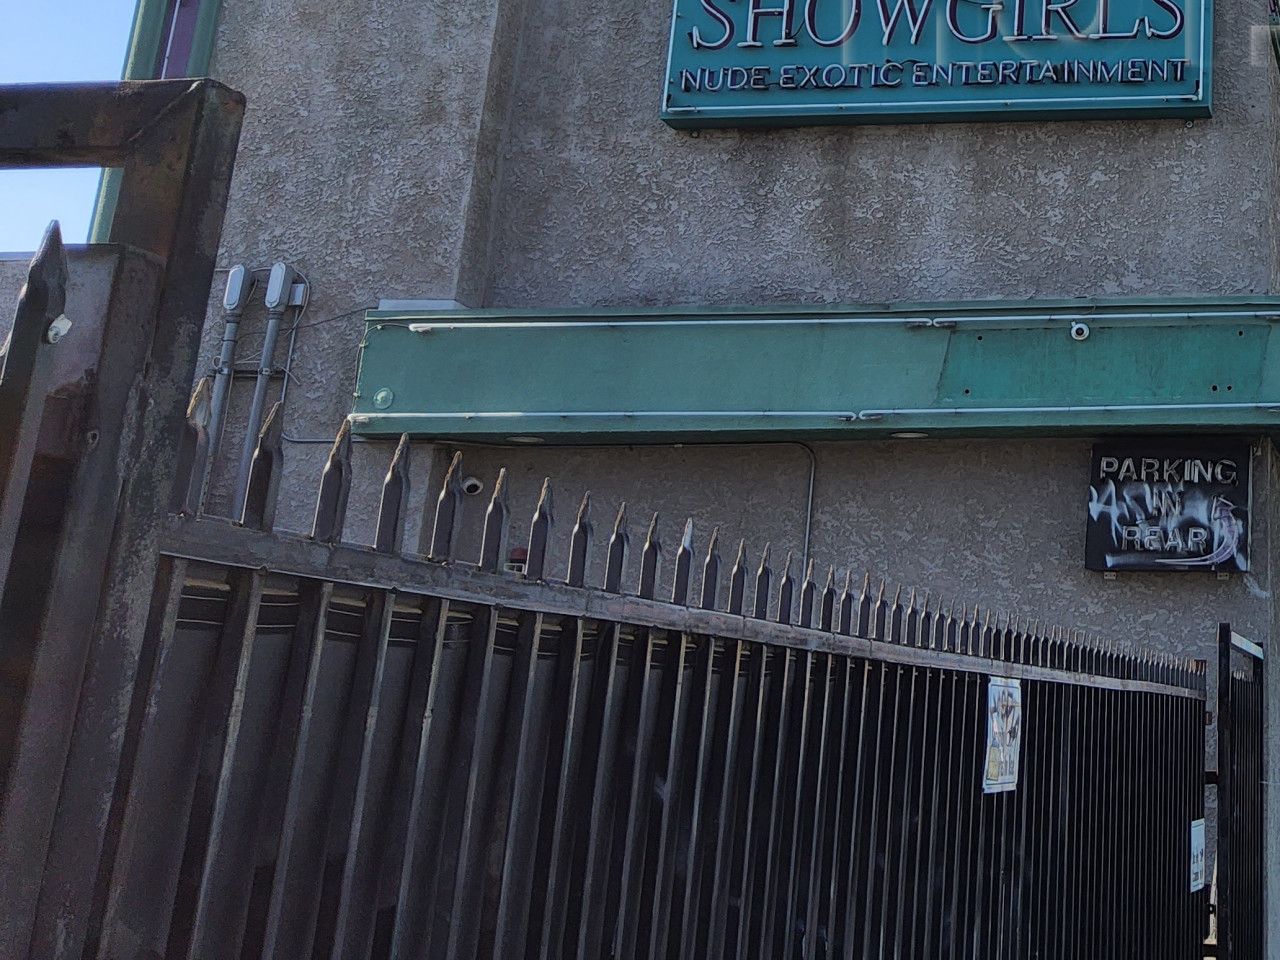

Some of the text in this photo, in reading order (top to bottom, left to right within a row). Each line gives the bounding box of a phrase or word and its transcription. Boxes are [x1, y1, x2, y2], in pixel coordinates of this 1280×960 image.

[681, 58, 1190, 93] NUDE EXOTIC ENTERTAINMENT
[1100, 456, 1238, 485] PARKING
[1121, 525, 1210, 554] REAR
